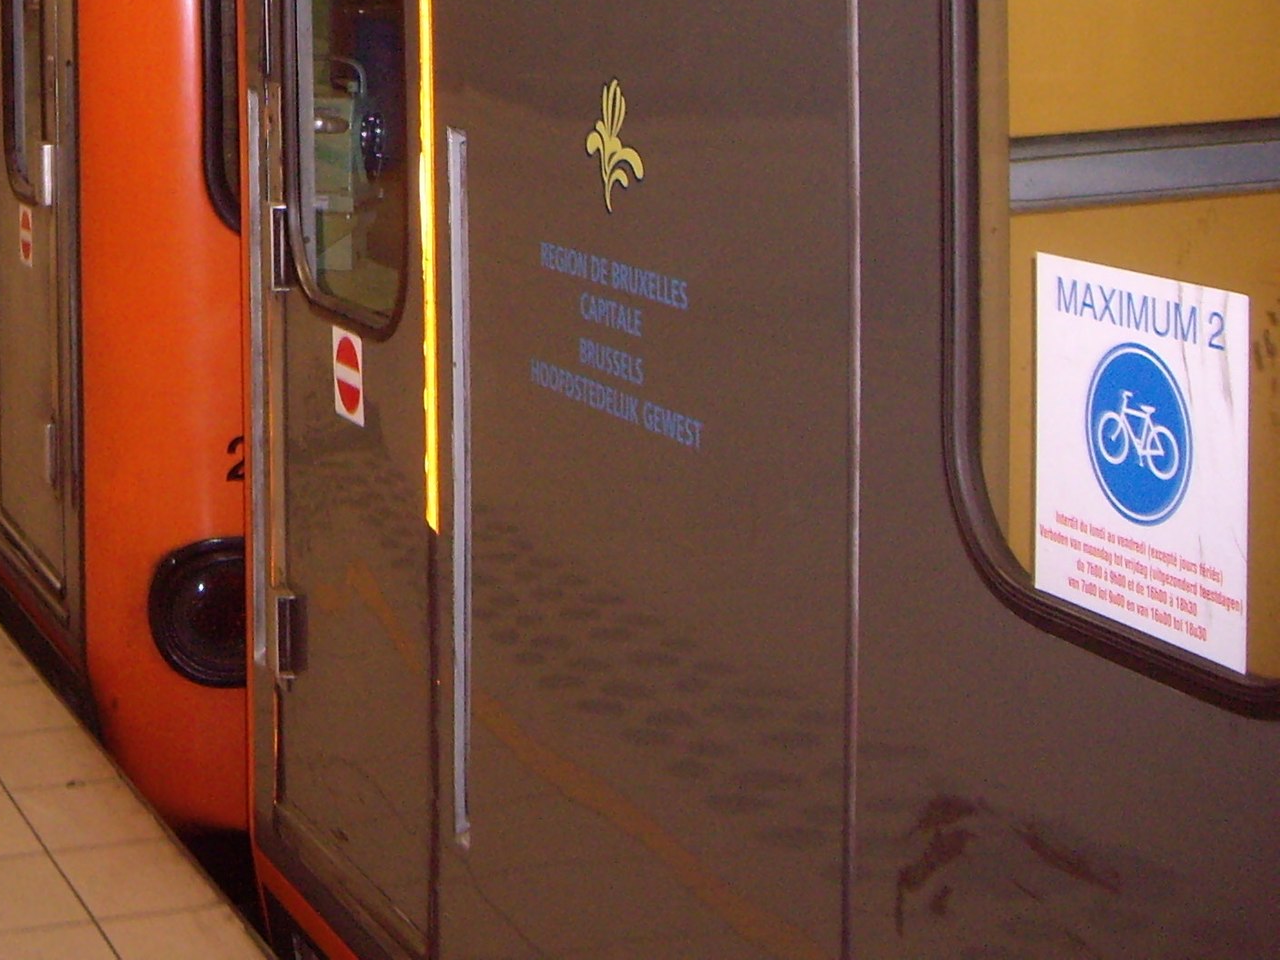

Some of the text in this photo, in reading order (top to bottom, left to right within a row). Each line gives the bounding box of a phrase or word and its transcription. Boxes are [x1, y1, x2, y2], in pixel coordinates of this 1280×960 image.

[540, 241, 687, 311] REGION DE BRUXELLES
[579, 292, 641, 337] CAPITALE
[1057, 275, 1226, 352] MAXIMUM 2
[579, 337, 643, 386] BRUSSELS
[643, 399, 703, 449] GEWEST
